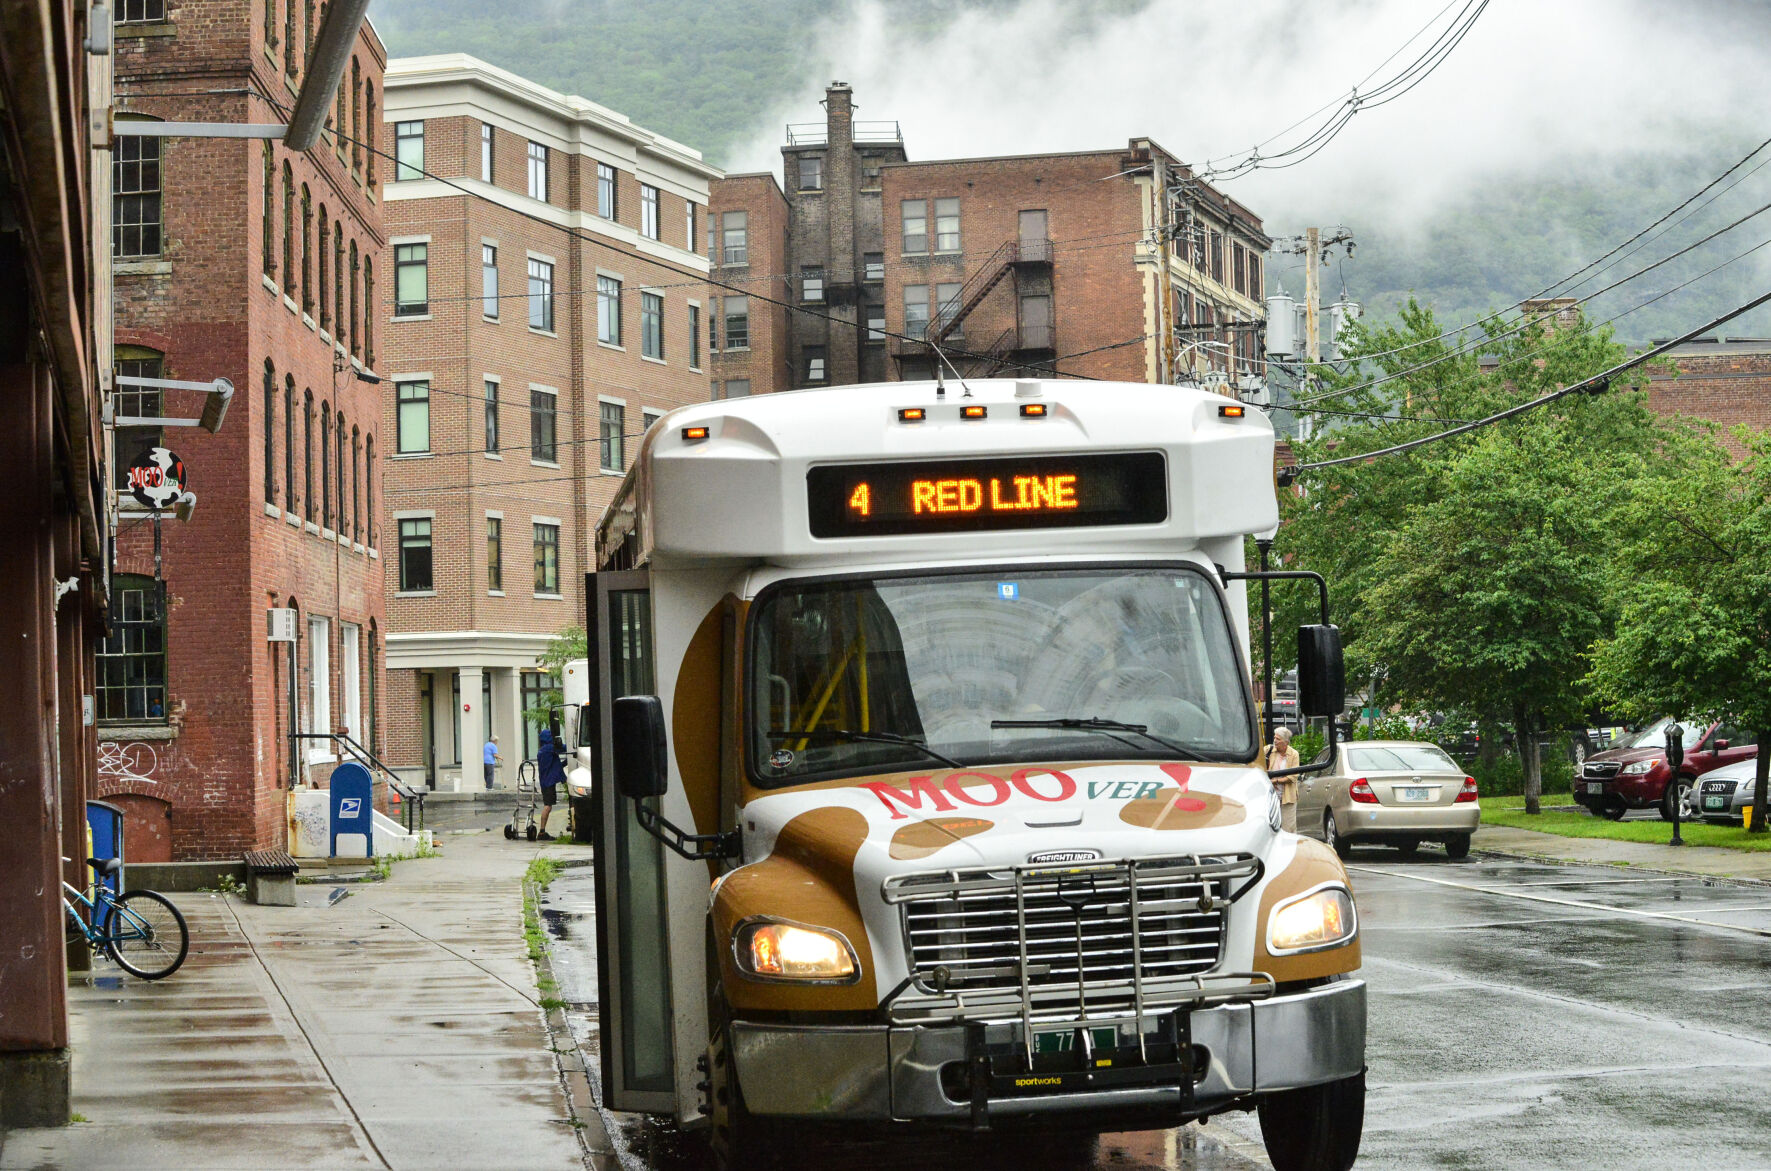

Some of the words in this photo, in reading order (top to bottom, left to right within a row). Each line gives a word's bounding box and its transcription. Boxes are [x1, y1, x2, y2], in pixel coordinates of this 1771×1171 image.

[850, 482, 870, 516] 4
[912, 478, 982, 514] RED
[991, 474, 1078, 510] LINE
[1015, 1077, 1062, 1087] sportworks
